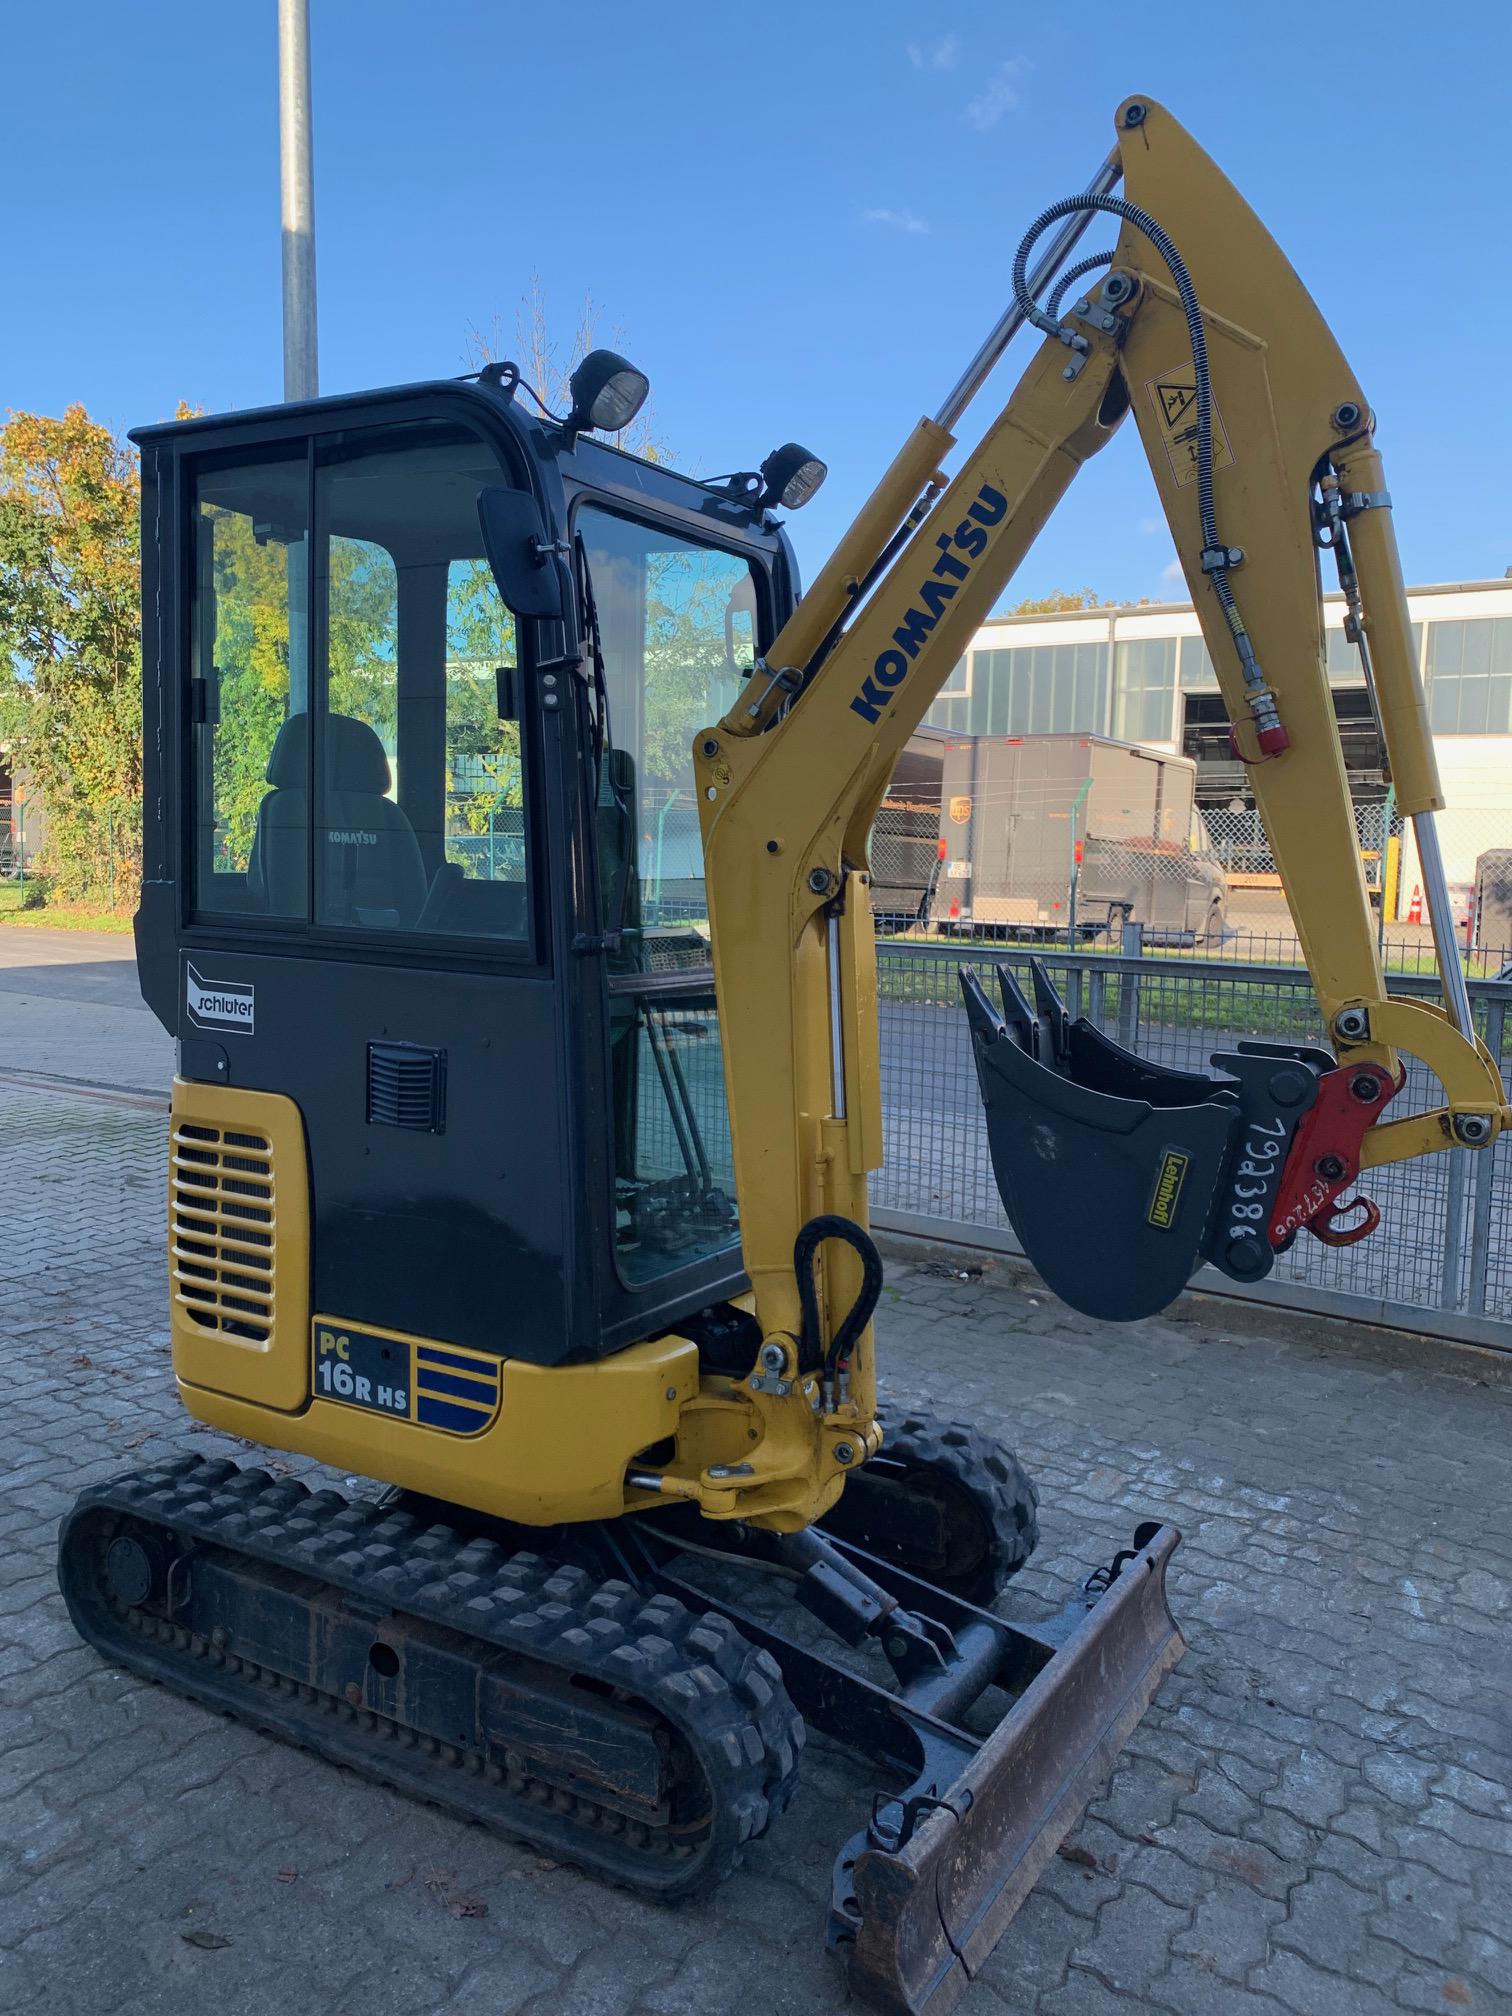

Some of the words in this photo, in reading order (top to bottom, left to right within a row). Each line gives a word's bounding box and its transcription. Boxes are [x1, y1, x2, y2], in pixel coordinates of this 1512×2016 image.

[850, 484, 1008, 725] KOMATSU
[328, 830, 377, 845] KOMATSU
[198, 995, 253, 1016] schlüter
[1153, 1156, 1185, 1225] Lehnhoff
[319, 1331, 350, 1361] PC
[318, 1360, 372, 1402] 16R
[377, 1385, 407, 1410] HS
